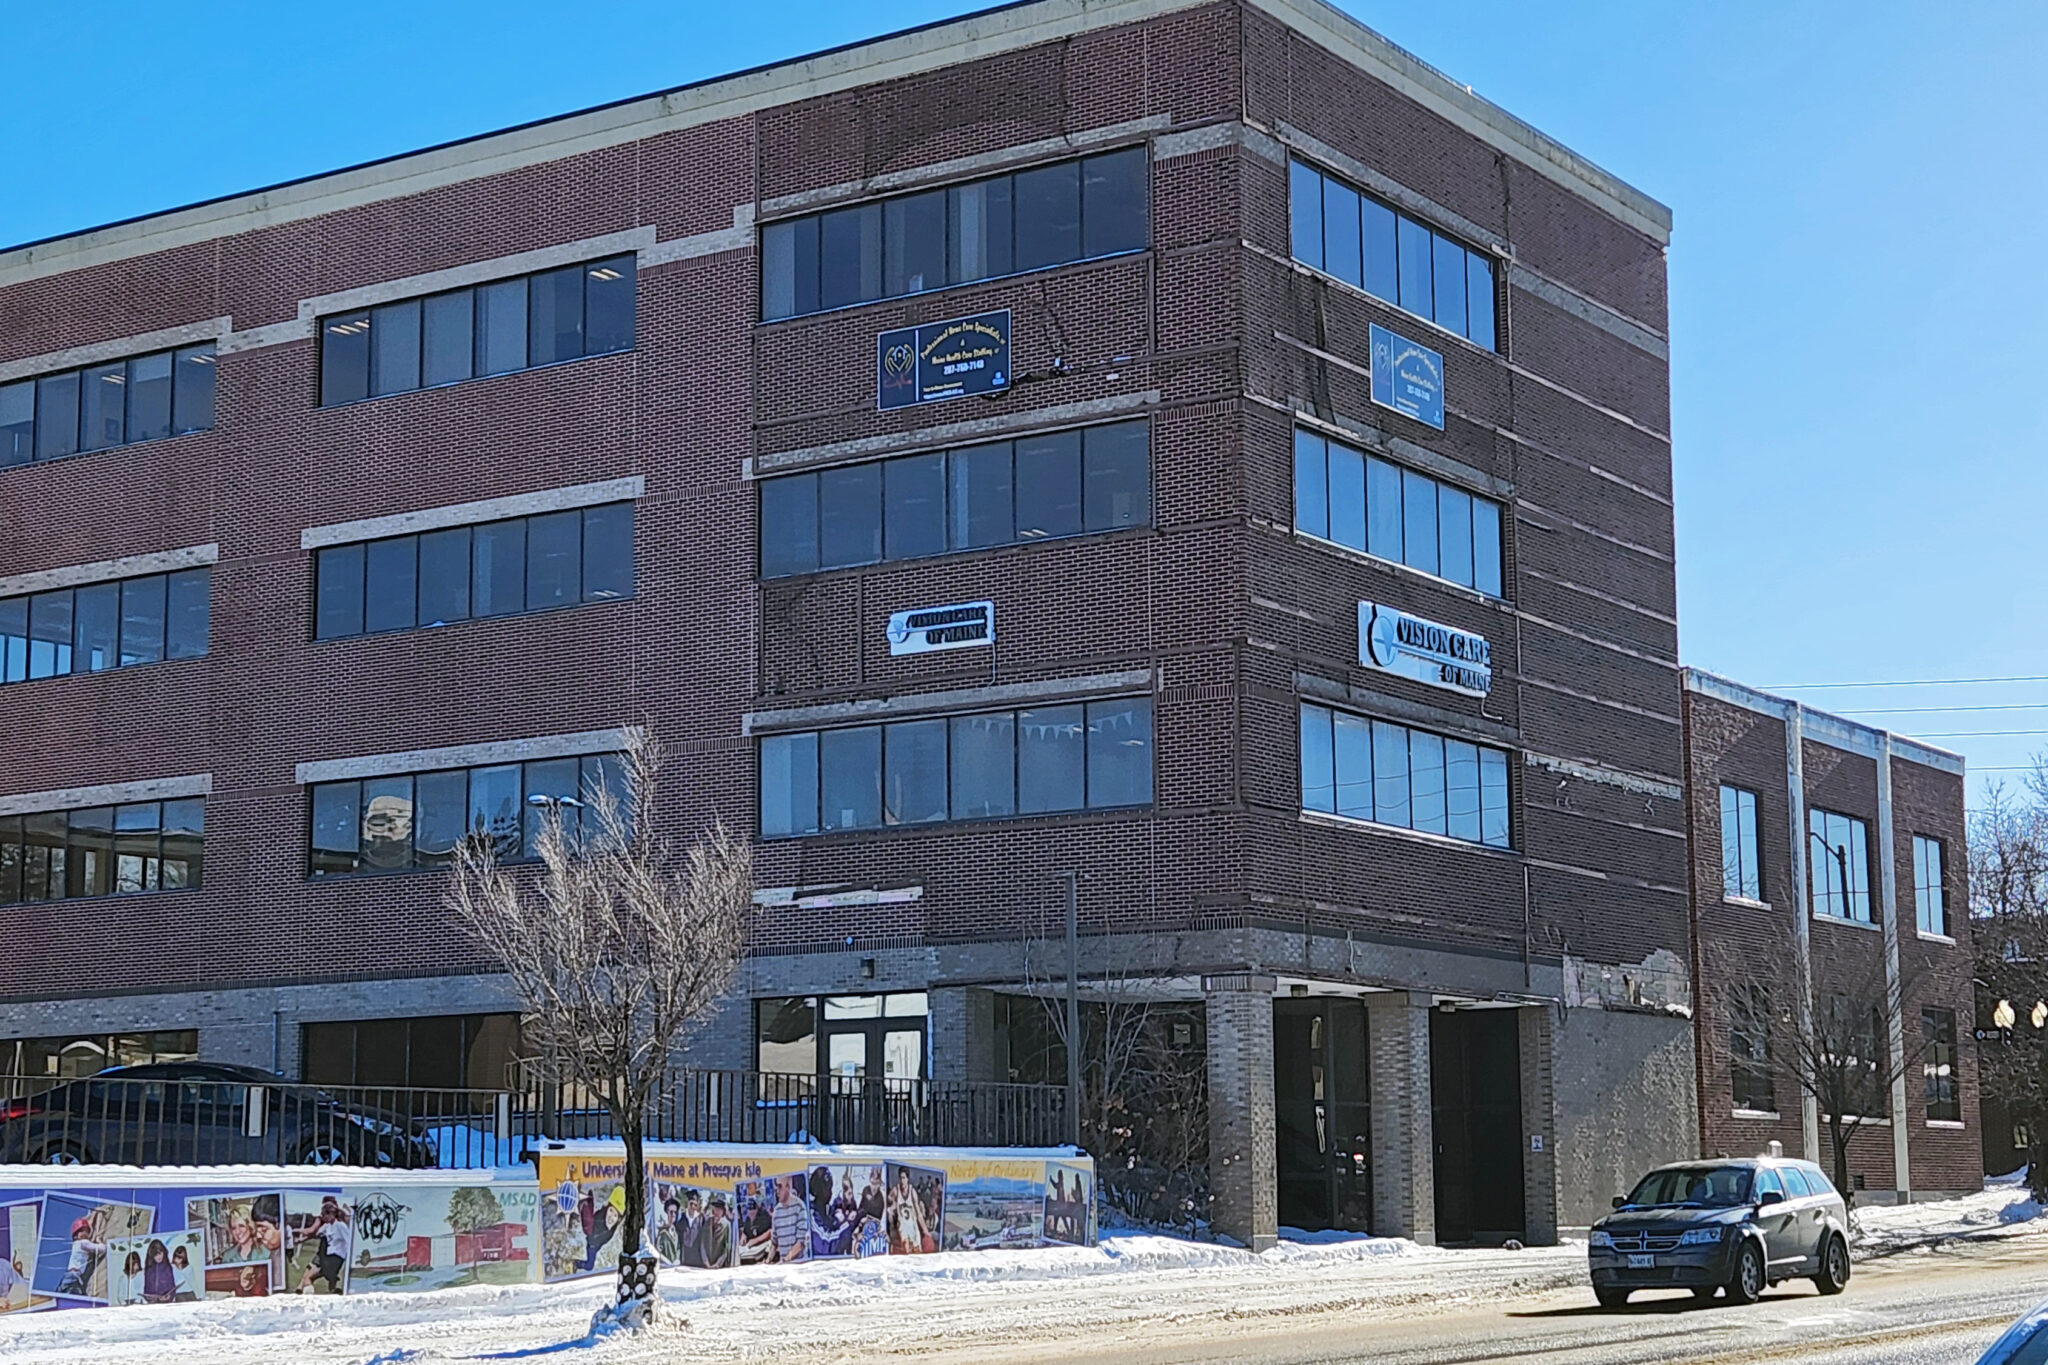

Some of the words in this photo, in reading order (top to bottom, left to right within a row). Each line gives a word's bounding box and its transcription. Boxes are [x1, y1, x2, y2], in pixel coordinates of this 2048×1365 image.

[909, 611, 953, 628] VISION
[953, 607, 987, 621] CARE
[928, 627, 942, 643] OF
[944, 624, 987, 642] MAINE
[1397, 616, 1450, 654] VISION
[1451, 632, 1491, 665] CARE
[1443, 664, 1460, 683] OF
[1460, 668, 1491, 693] MAINE
[582, 1160, 629, 1178] Universi
[653, 1161, 685, 1178] Maine
[688, 1162, 699, 1178] at
[702, 1162, 742, 1182] Presque
[744, 1160, 762, 1177] Isle
[950, 1161, 978, 1179] North
[981, 1161, 992, 1178] of
[992, 1161, 1037, 1178] Ordinary
[500, 1192, 537, 1206] MSAD
